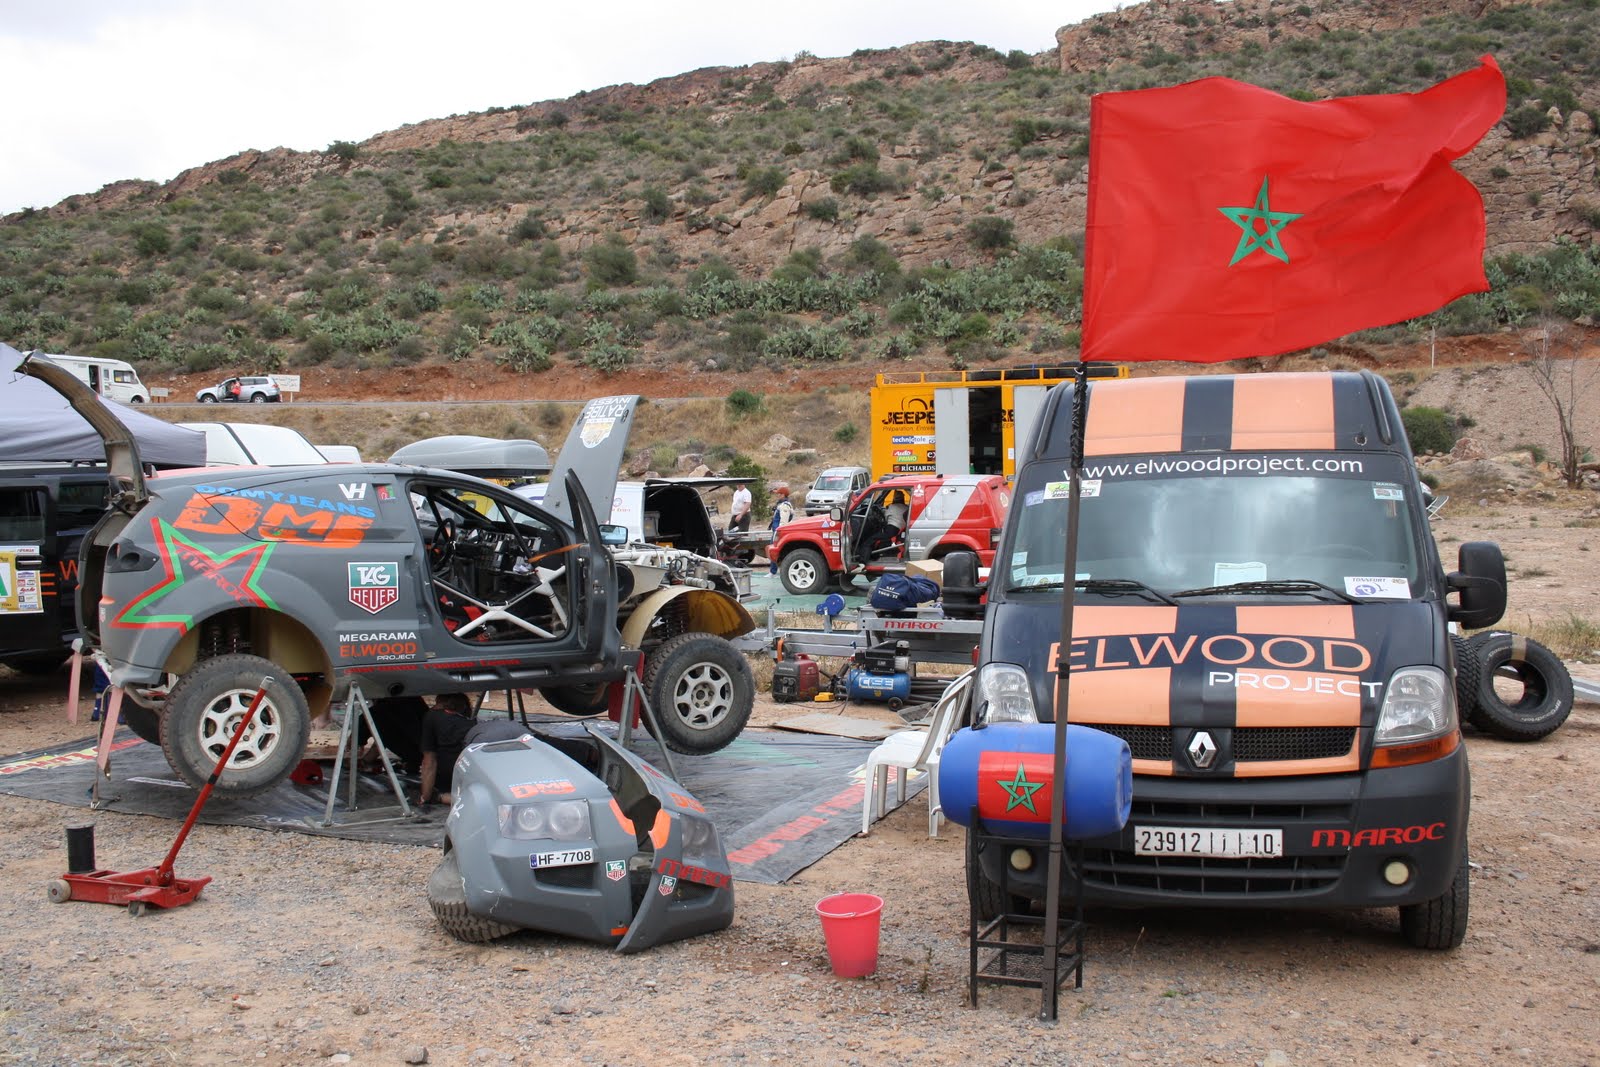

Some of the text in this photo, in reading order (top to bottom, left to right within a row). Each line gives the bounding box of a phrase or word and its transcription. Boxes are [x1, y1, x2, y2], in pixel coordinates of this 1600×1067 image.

[194, 485, 376, 518] DOMYJEANS
[356, 565, 391, 586] TAG
[353, 589, 395, 611] HEUER
[884, 621, 944, 630] MAROC
[339, 631, 417, 642] MEGARAMA
[339, 642, 417, 658] ELWOOD
[1046, 634, 1372, 673] ELWOOD
[1209, 671, 1383, 698] PROJECT
[1141, 831, 1201, 853] 23912
[1252, 834, 1273, 854] 10
[1311, 822, 1446, 847] MAROC
[538, 851, 591, 865] HF-7708
